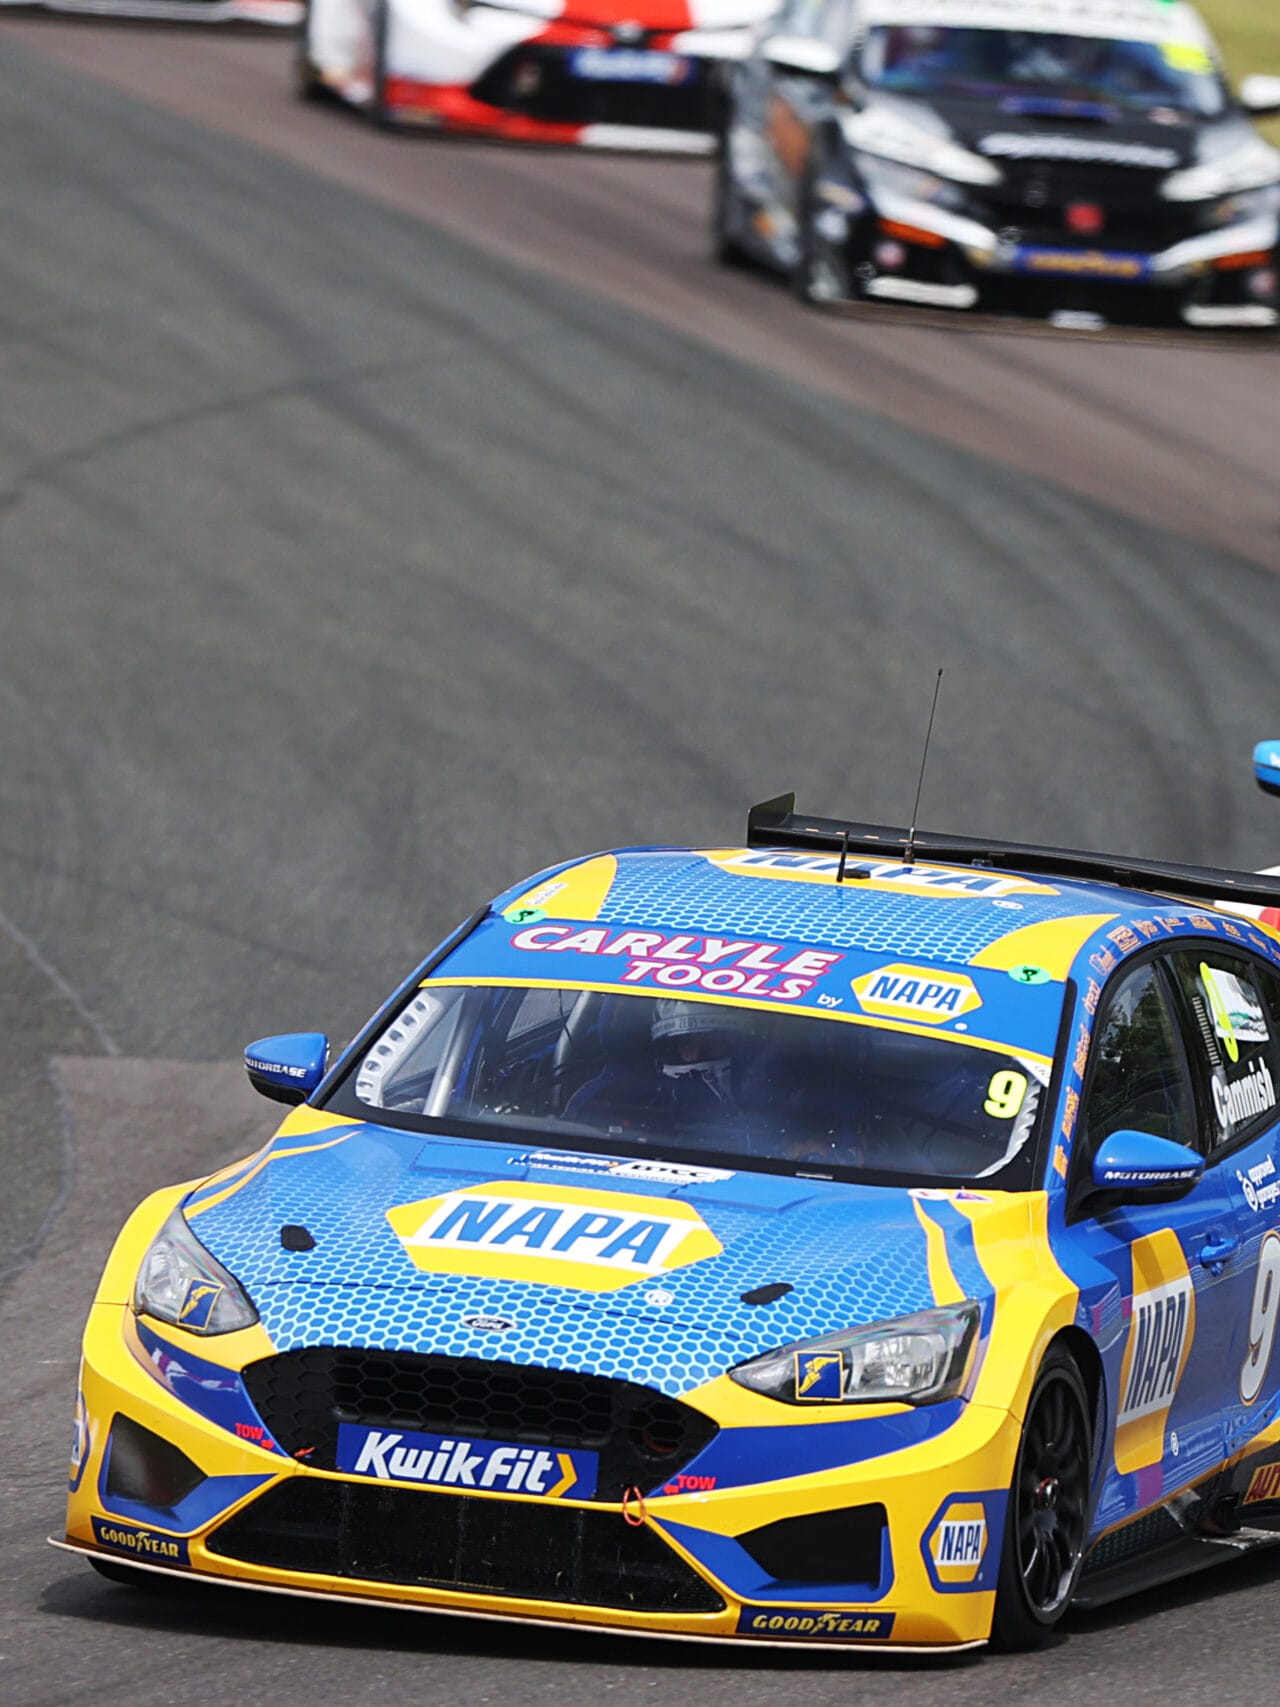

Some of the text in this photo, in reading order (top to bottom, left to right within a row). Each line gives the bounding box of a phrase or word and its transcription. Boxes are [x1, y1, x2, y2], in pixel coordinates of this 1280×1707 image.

[743, 853, 998, 892] NAPA
[510, 925, 842, 977] CARLYLE
[620, 960, 815, 1000] TOOLS
[869, 976, 963, 1012] NAPA
[816, 993, 844, 1009] by
[983, 1069, 1029, 1120] 9
[1211, 1056, 1277, 1128] Cammish
[1104, 1169, 1196, 1180] MOTORBASE
[430, 1200, 671, 1265] NAPA
[1124, 1291, 1185, 1413] NAPA
[235, 1423, 264, 1440] TOW
[354, 1431, 554, 1493] KwikFit
[677, 1475, 717, 1490] TOW
[100, 1526, 179, 1558] GOODYEAR
[939, 1524, 983, 1560] NAPA
[752, 1612, 881, 1634] GOODYEAR
